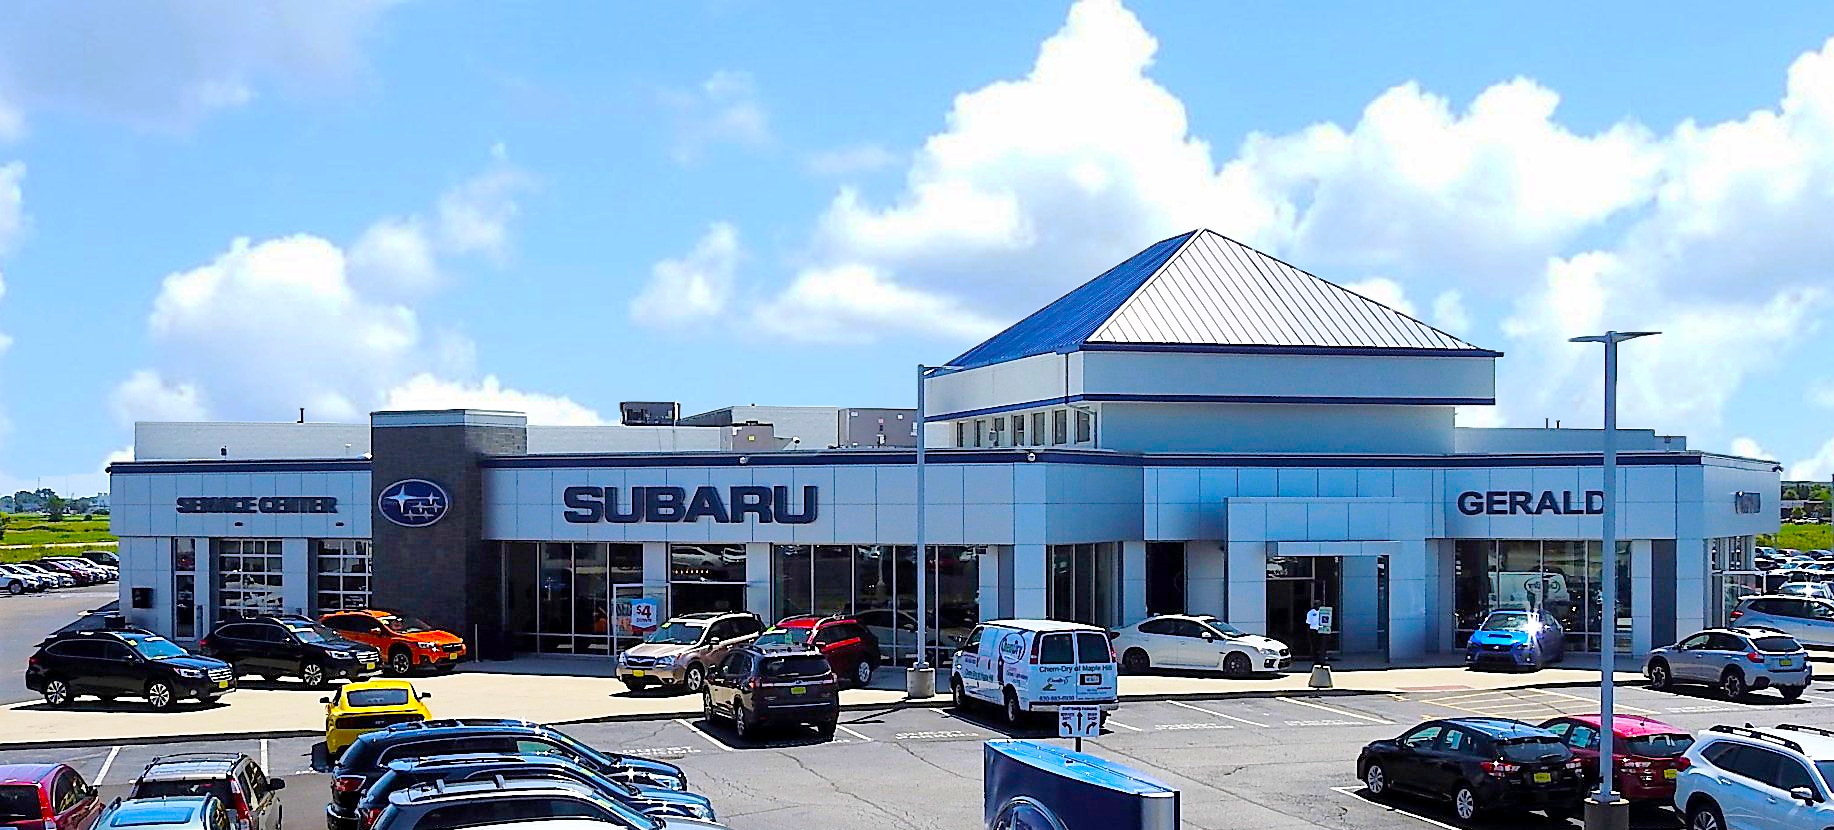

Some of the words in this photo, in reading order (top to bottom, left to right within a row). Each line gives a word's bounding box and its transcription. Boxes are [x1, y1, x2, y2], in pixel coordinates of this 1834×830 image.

[176, 497, 257, 513] SERVICE
[258, 497, 338, 513] CENTER
[563, 485, 818, 524] SUBARU
[1457, 490, 1604, 515] GERALD
[1039, 665, 1073, 674] Chem-Dry
